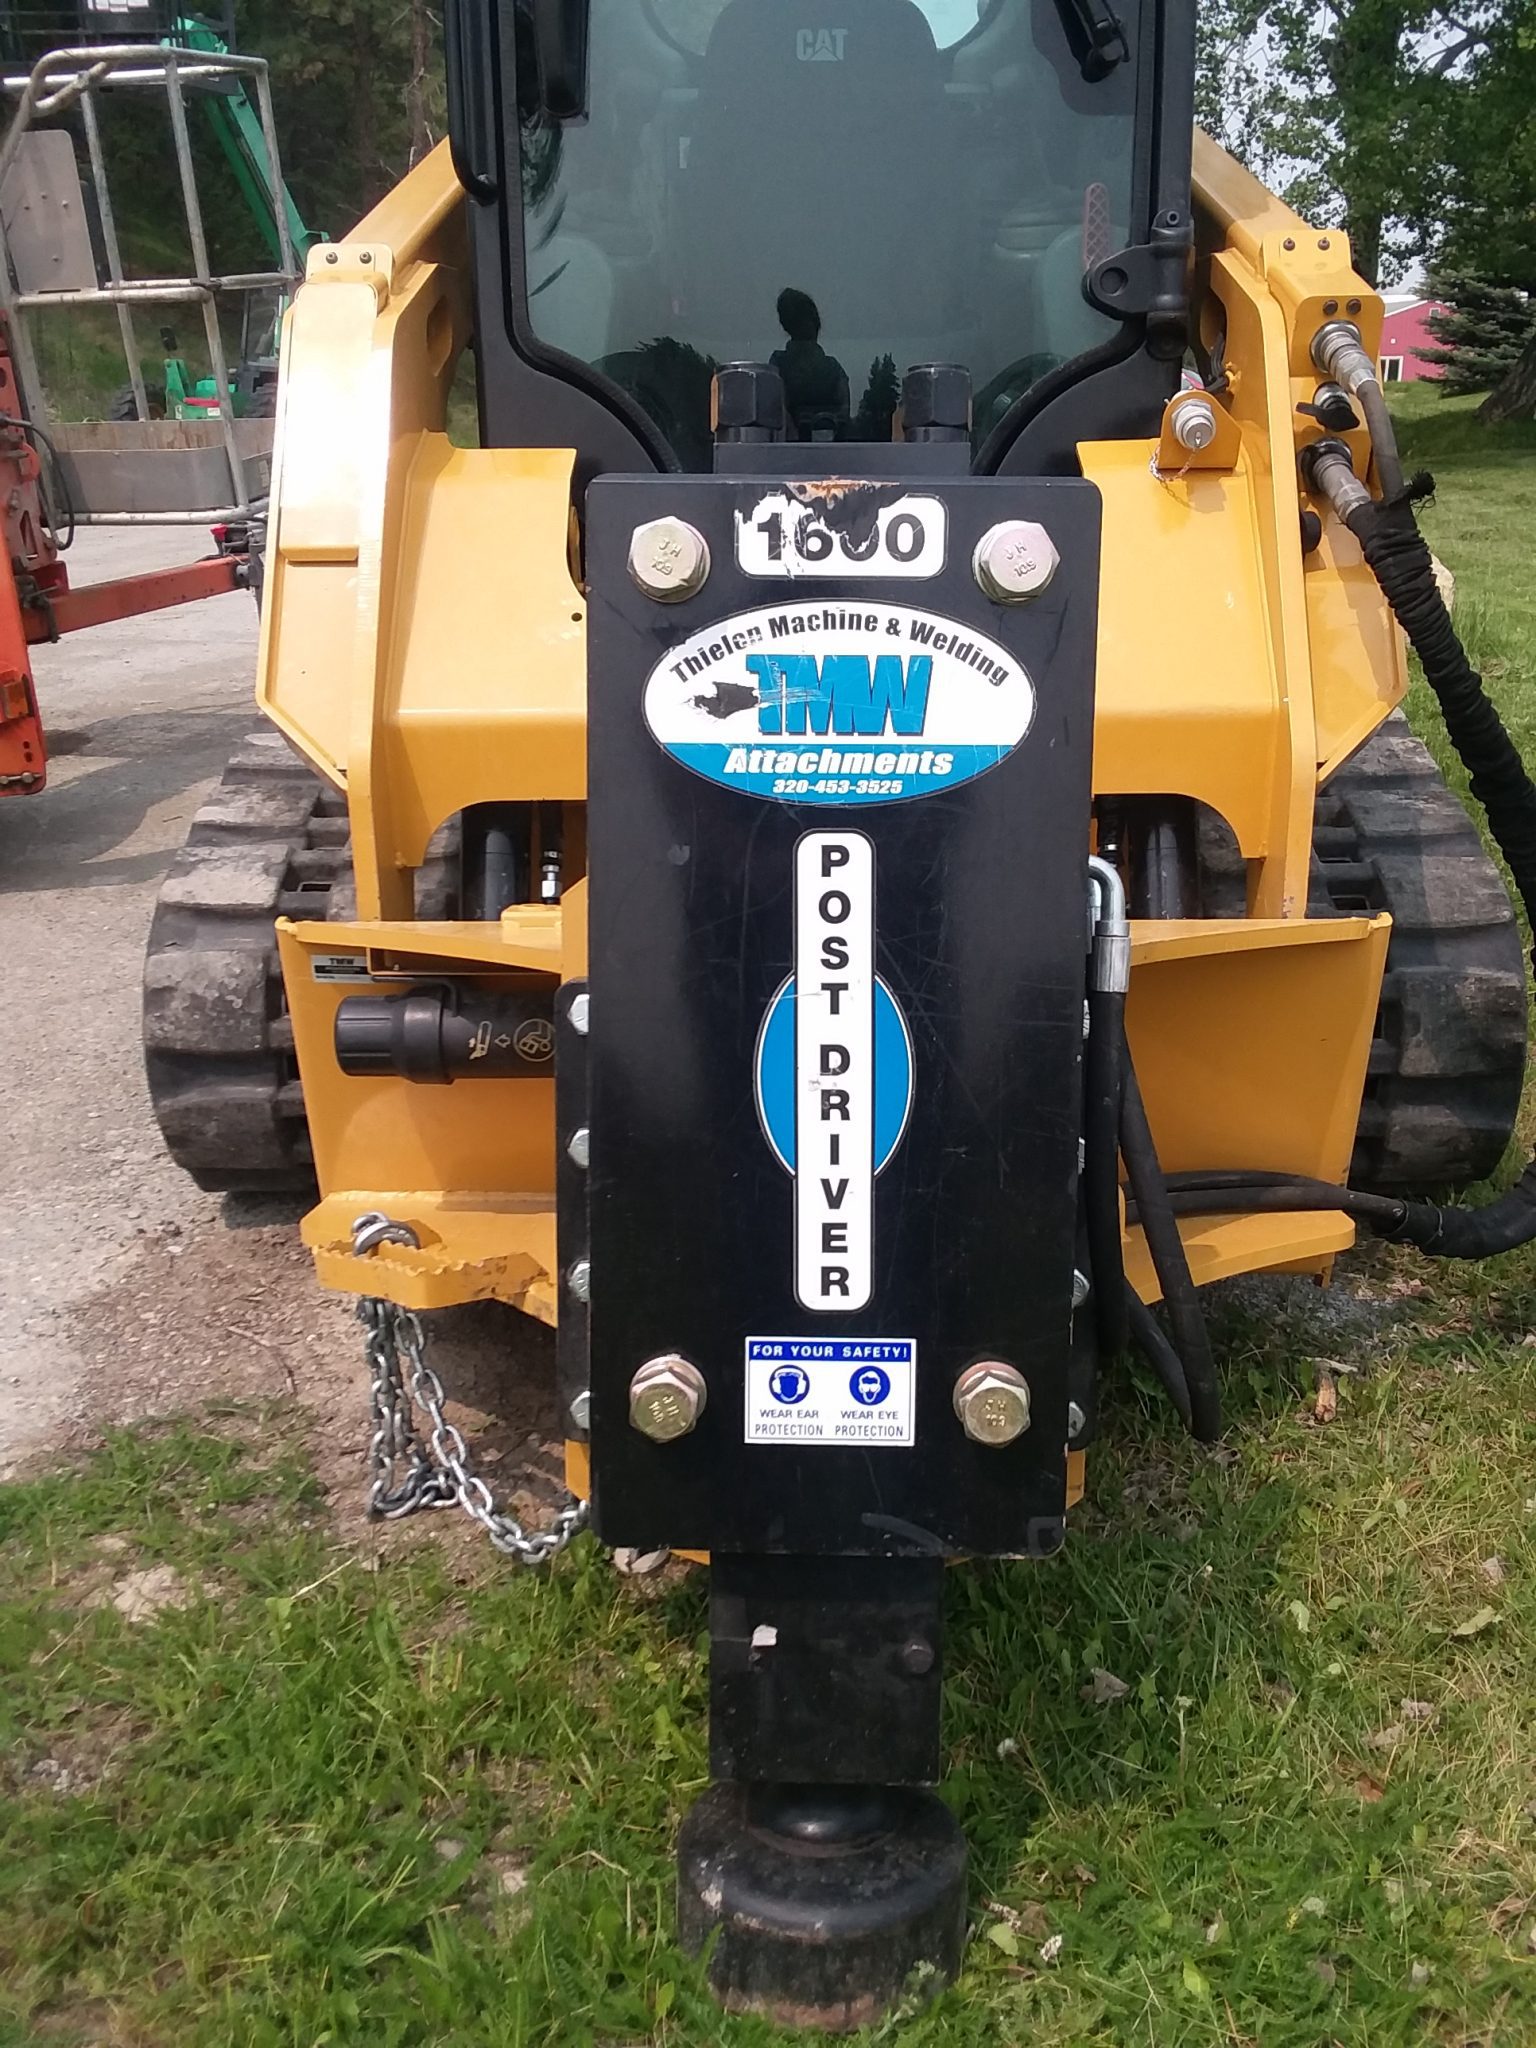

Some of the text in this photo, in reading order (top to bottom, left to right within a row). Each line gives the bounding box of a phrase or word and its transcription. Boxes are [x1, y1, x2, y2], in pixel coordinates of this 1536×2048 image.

[796, 28, 848, 61] CAT
[669, 608, 1010, 687] Thielen Machine & Welding
[745, 654, 933, 737] TMW
[723, 748, 955, 776] Attachments
[772, 778, 904, 795] 320-453-3525
[818, 844, 851, 1016] POST
[819, 1043, 851, 1297] DRIVER
[752, 1344, 907, 1359] FOR YOUR SAFETY!
[760, 1408, 819, 1419] WEAR EAR
[840, 1410, 899, 1421] WEAR EYE
[754, 1423, 824, 1437] PROTECTION
[834, 1425, 904, 1438] PROTECTION
